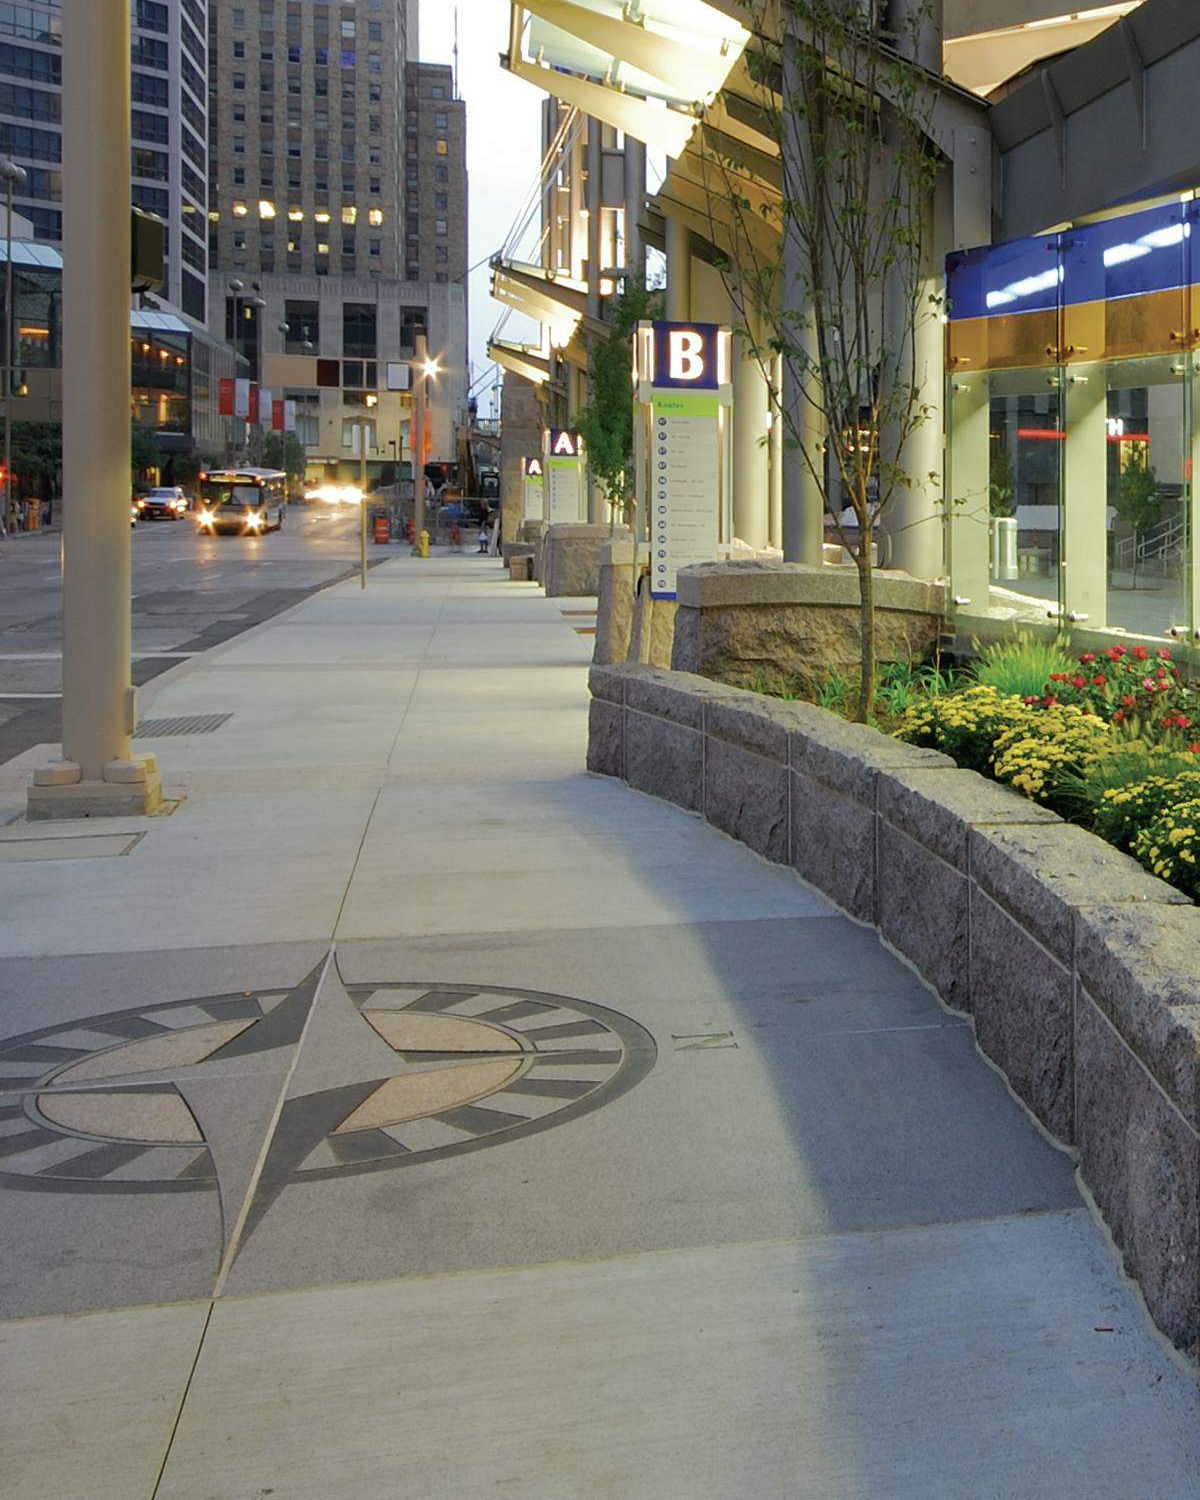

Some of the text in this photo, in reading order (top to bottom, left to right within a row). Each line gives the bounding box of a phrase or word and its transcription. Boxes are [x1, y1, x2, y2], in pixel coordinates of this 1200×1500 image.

[669, 331, 704, 380] B
[554, 431, 575, 454] A
[528, 459, 542, 474] A
